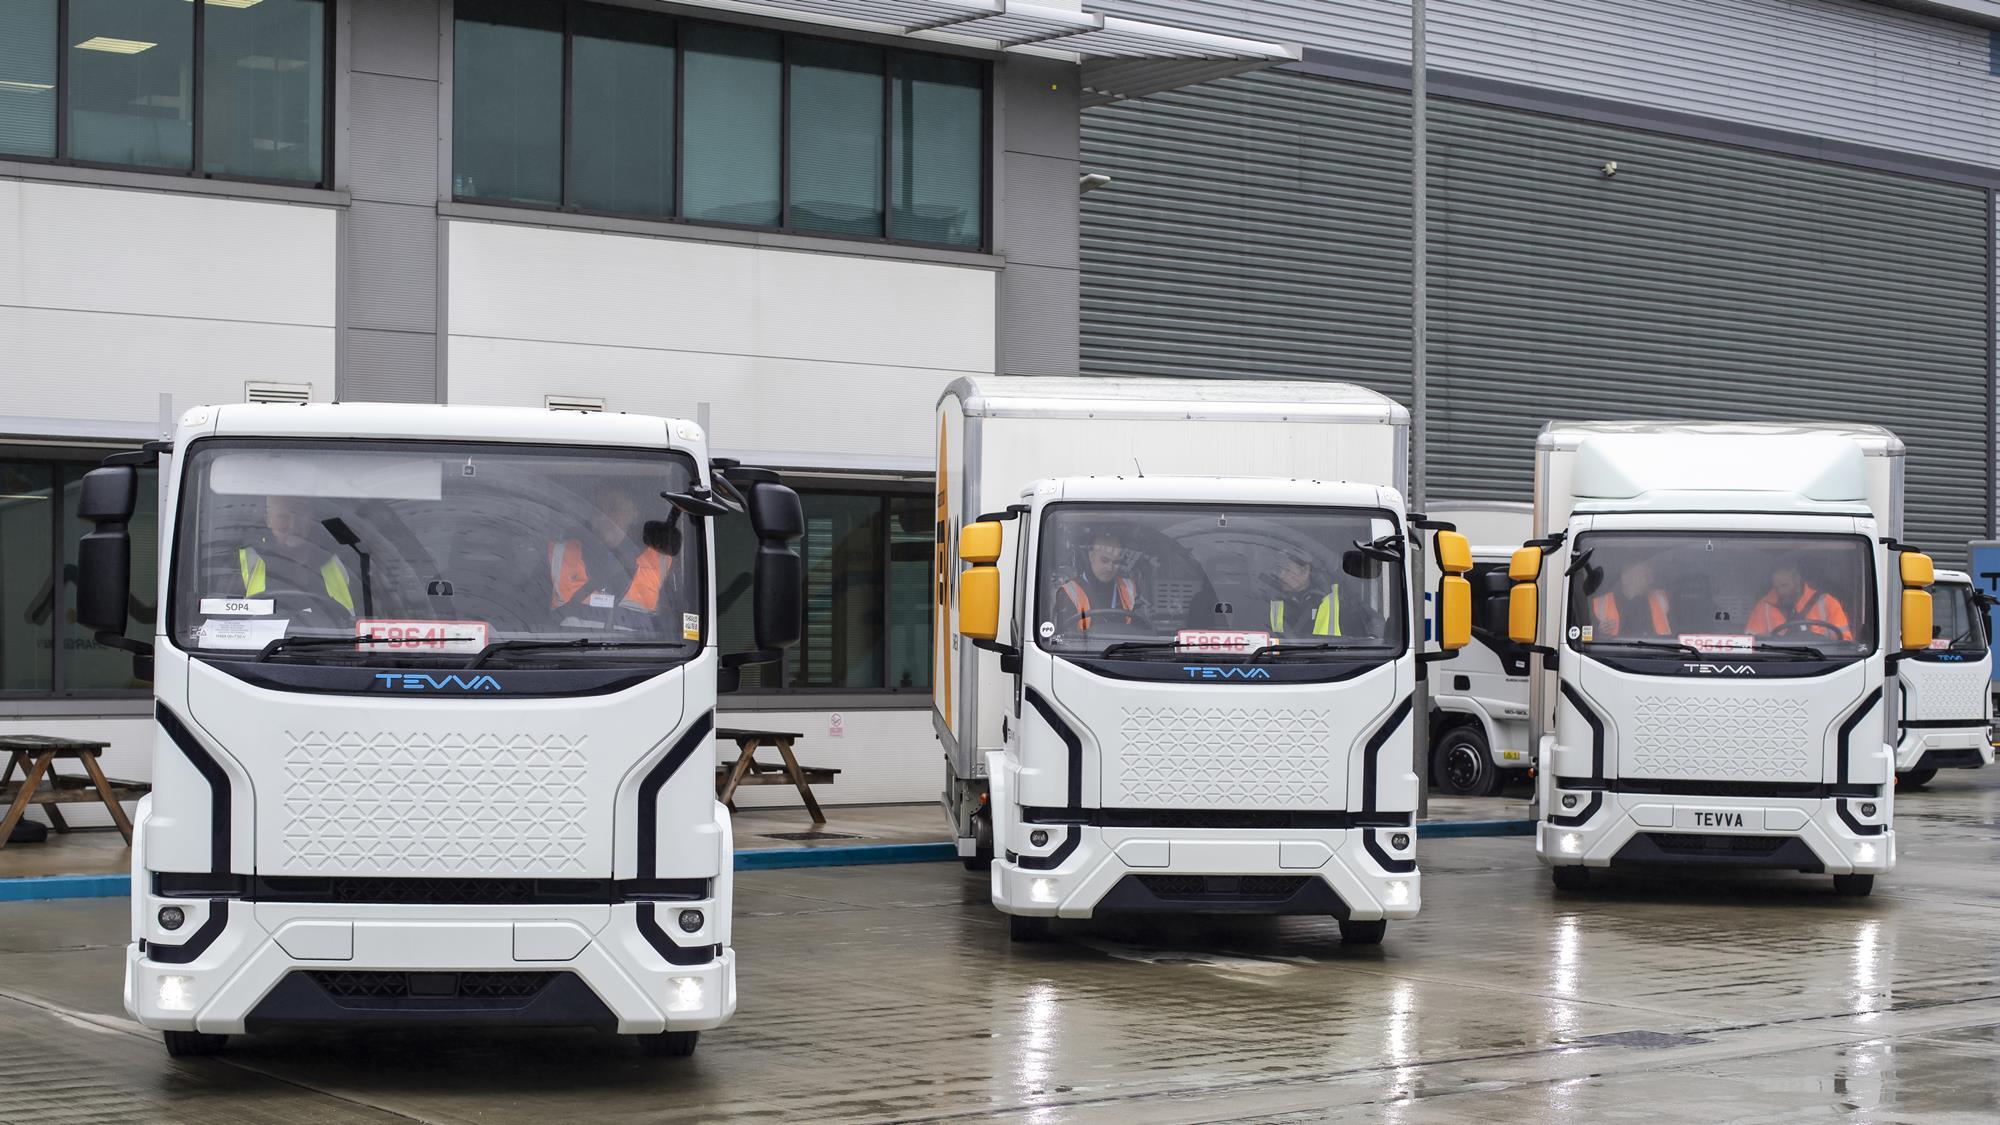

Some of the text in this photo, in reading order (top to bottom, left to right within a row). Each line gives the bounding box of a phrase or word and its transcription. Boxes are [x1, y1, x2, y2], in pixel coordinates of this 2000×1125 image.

[225, 603, 249, 611] SOP4
[1183, 666, 1270, 679] TEVVA
[1683, 663, 1756, 674] TEVVA
[375, 673, 502, 691] TEVVA
[1694, 812, 1743, 827] TEVVA
